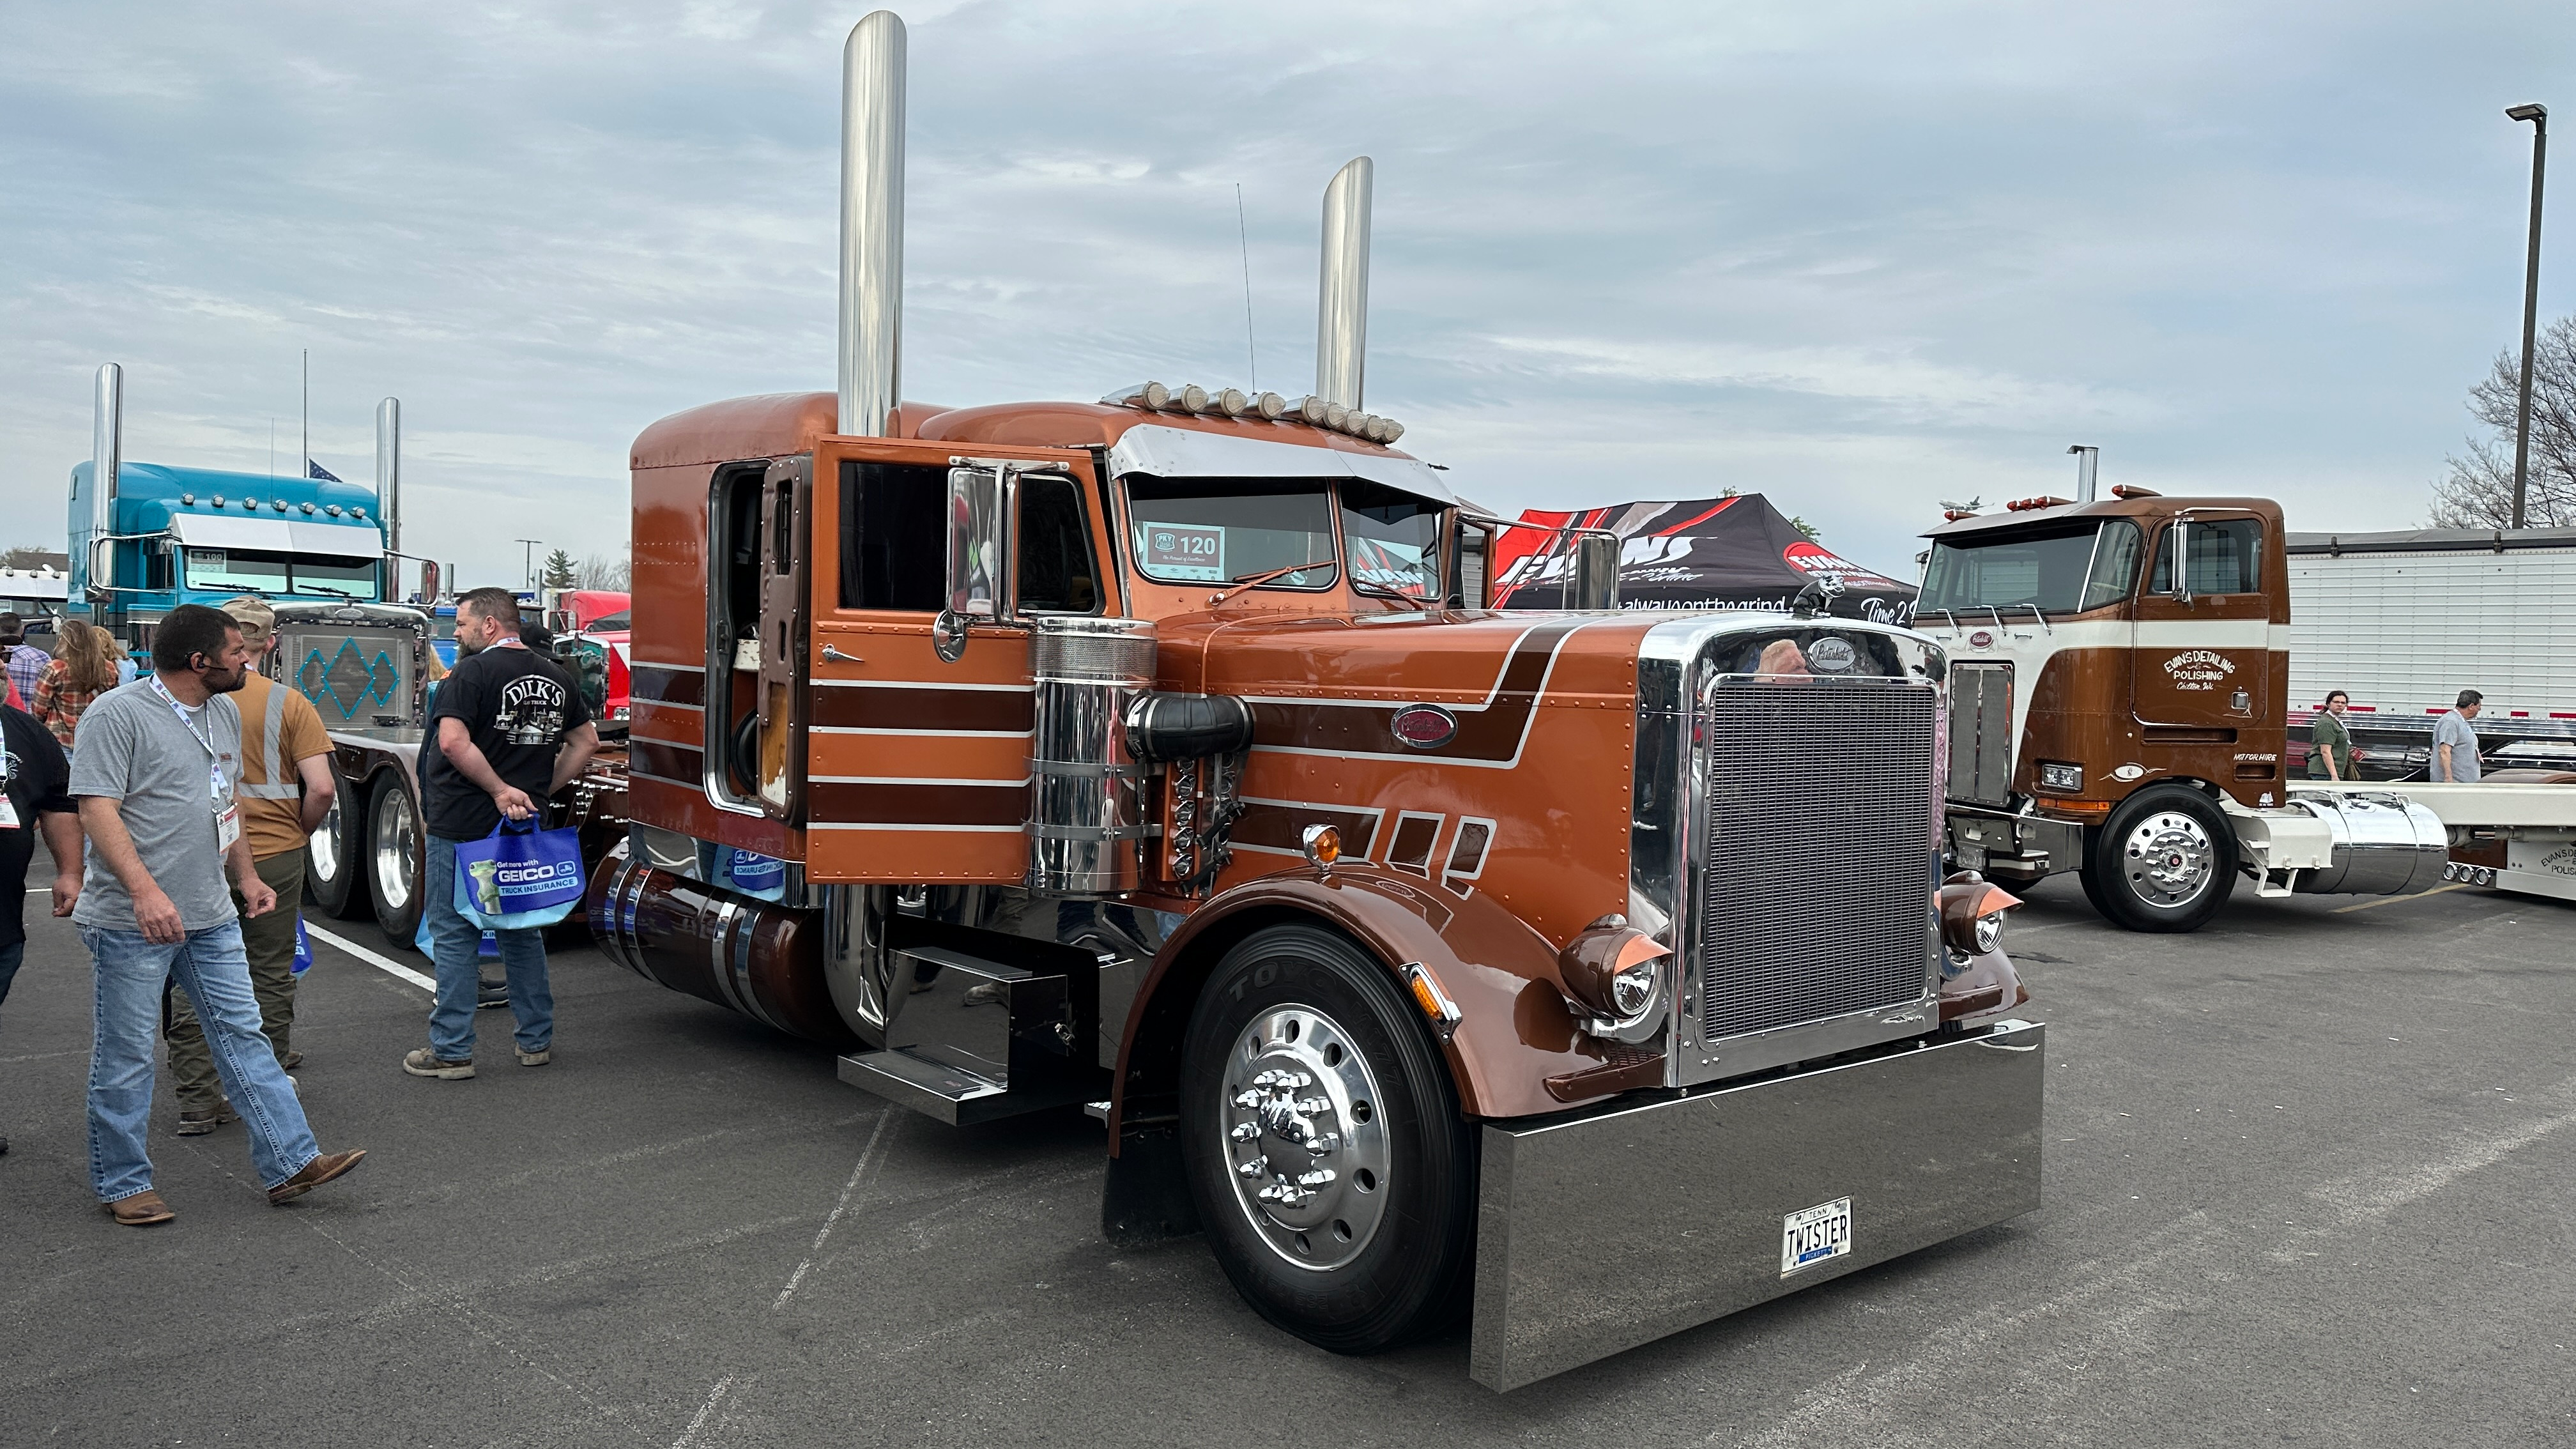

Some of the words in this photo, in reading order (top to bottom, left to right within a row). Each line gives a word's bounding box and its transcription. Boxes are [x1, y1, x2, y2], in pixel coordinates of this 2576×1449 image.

[1181, 536, 1216, 555] 120
[1860, 597, 1896, 625] Time
[1897, 600, 1907, 625] 2
[1816, 643, 1853, 662] Peterbilt
[2164, 650, 2193, 673] EVAN'S
[2193, 650, 2235, 674] DETAILING
[2174, 670, 2223, 681] POLISHING
[506, 680, 563, 707] DILK'S
[1401, 715, 1446, 733] Peterbilt
[523, 859, 539, 867] with
[2541, 848, 2568, 867] EVAN'S
[498, 865, 555, 883] GEICO
[2551, 864, 2576, 875] POLIS
[501, 886, 523, 894] TRUCK
[524, 878, 574, 893] INSURANCE
[1228, 960, 1337, 1003] TOYO
[1809, 1208, 1827, 1218] TENN
[1788, 1215, 1847, 1257] TWISTER
